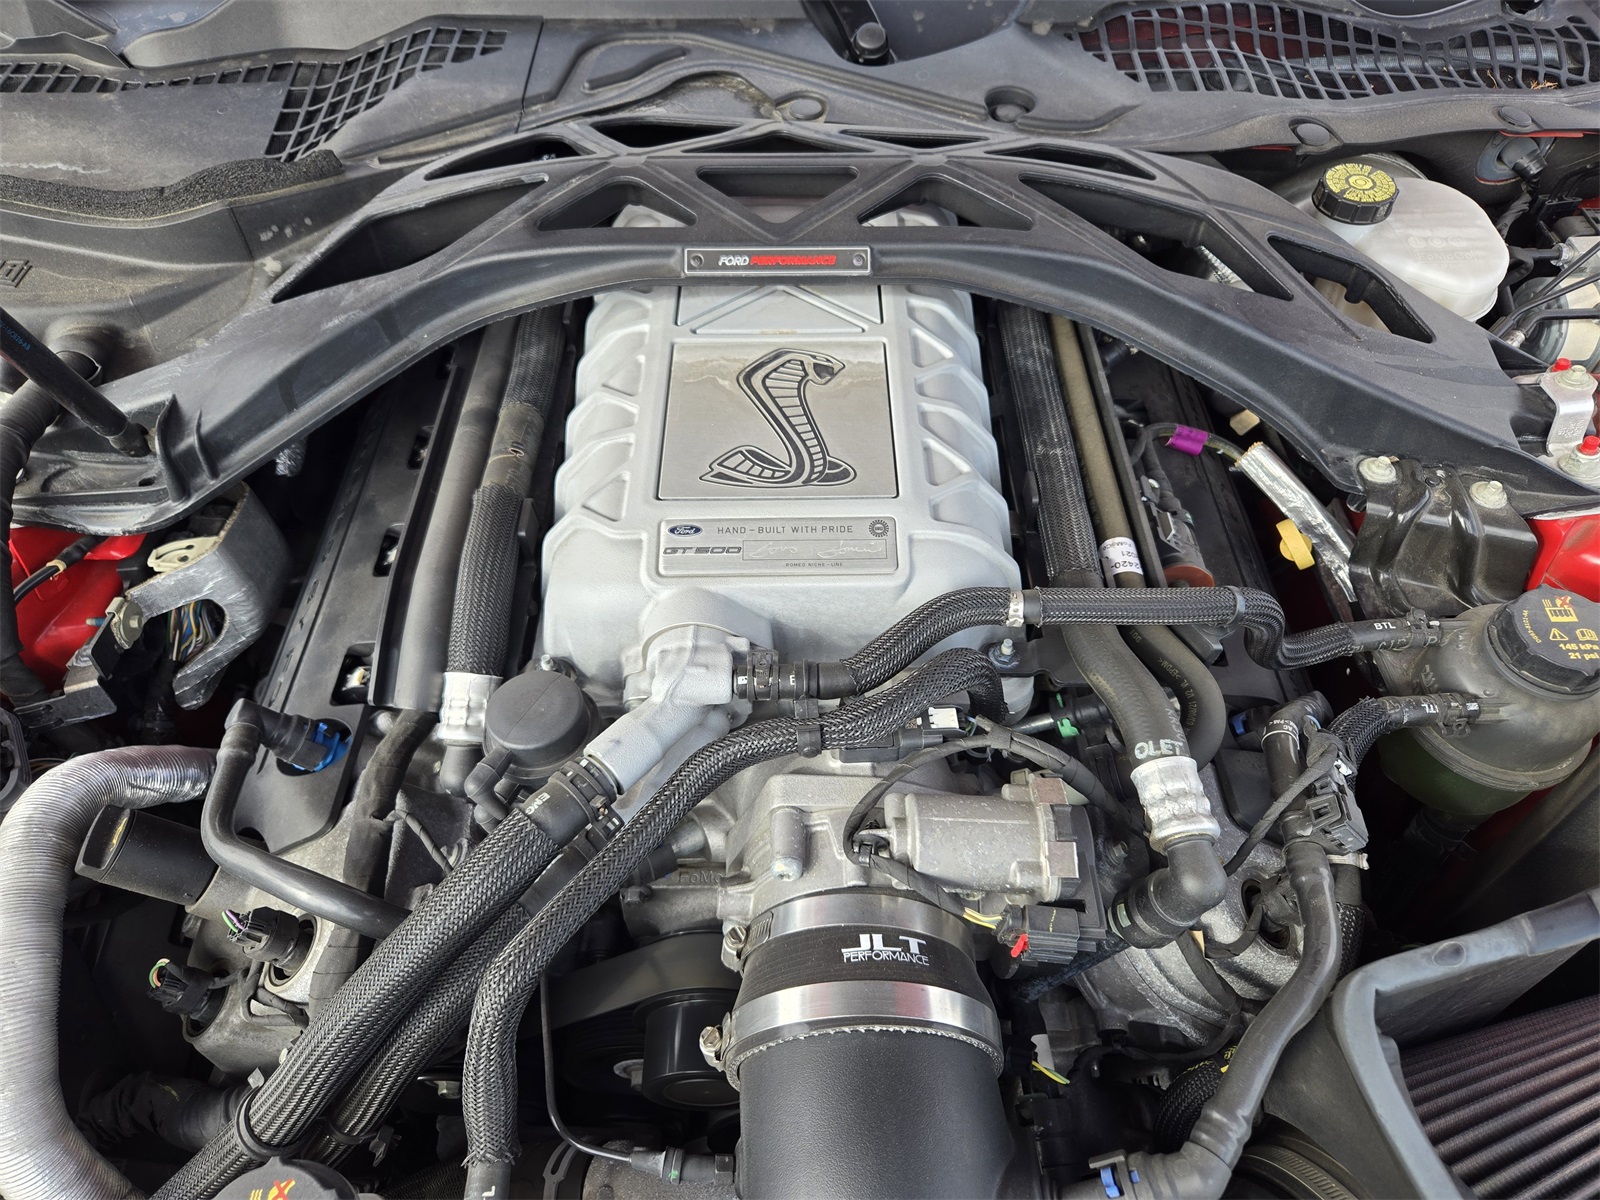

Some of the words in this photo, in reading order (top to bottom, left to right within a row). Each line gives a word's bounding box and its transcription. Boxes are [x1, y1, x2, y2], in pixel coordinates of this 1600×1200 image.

[718, 255, 749, 266] FORD
[750, 255, 837, 266] PERFORMANCE
[791, 525, 818, 533] WITH
[821, 525, 854, 533] PRIDE
[663, 546, 742, 555] GT500
[1373, 621, 1396, 631] BTL
[1559, 643, 1578, 651] 145
[1580, 643, 1600, 651] kPa
[1568, 652, 1581, 660] 21
[1583, 652, 1600, 660] psi
[1134, 738, 1184, 760] OLET
[525, 792, 551, 815] ENG
[841, 934, 926, 954] JLT
[843, 950, 930, 966] PERFORMANCE
